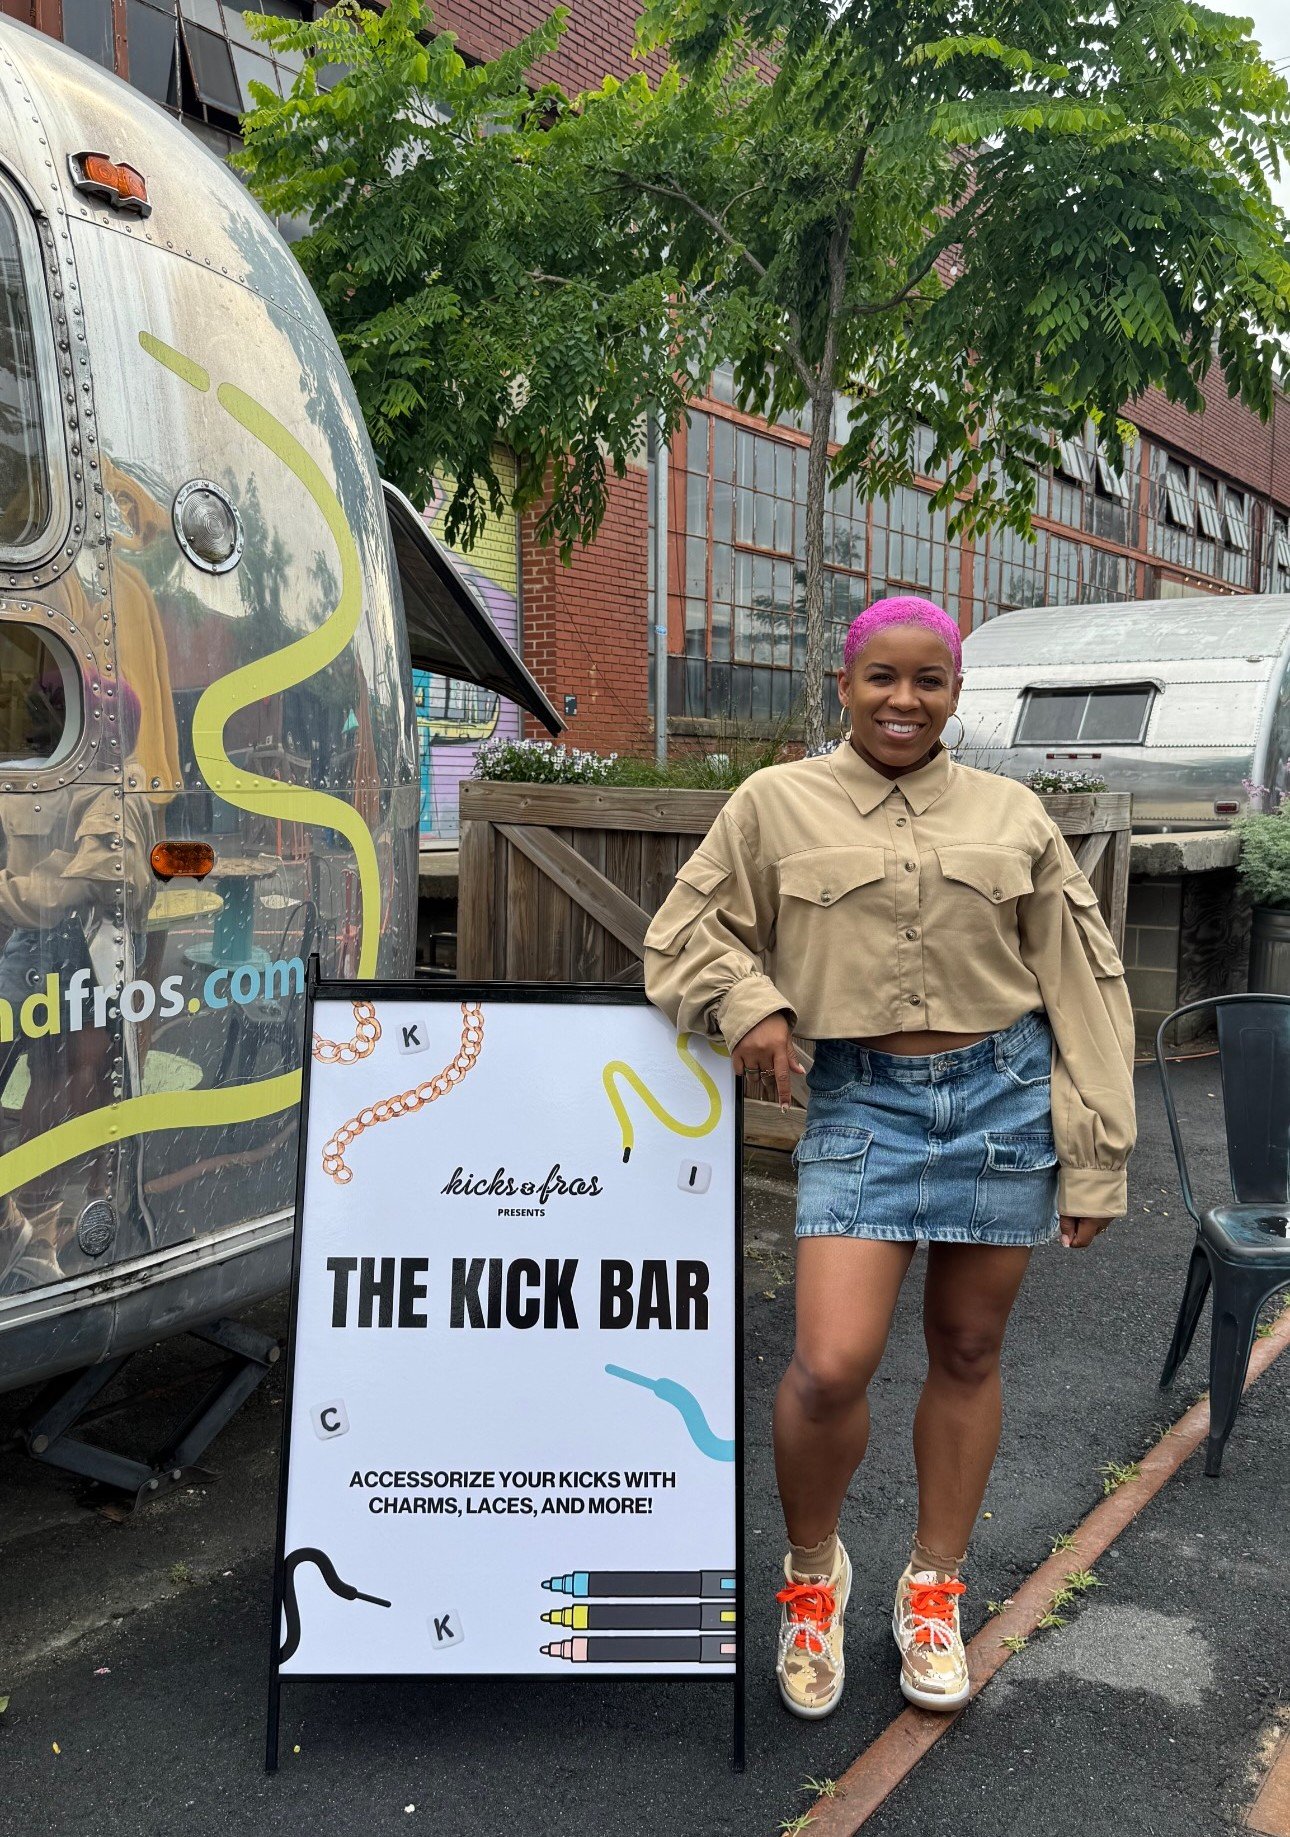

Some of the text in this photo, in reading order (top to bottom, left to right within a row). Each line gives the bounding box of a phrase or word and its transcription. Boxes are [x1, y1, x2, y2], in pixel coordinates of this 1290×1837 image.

[402, 1024, 421, 1048] K
[497, 1208, 546, 1217] PRESENTS
[326, 1256, 710, 1331] THE KICK BAR
[320, 1407, 341, 1432] C
[349, 1470, 676, 1489] ACCESSORIZE YOUR KICKS WITH
[368, 1496, 653, 1518] CHARMS, LACES, AND MORE!
[433, 1614, 455, 1641] K
